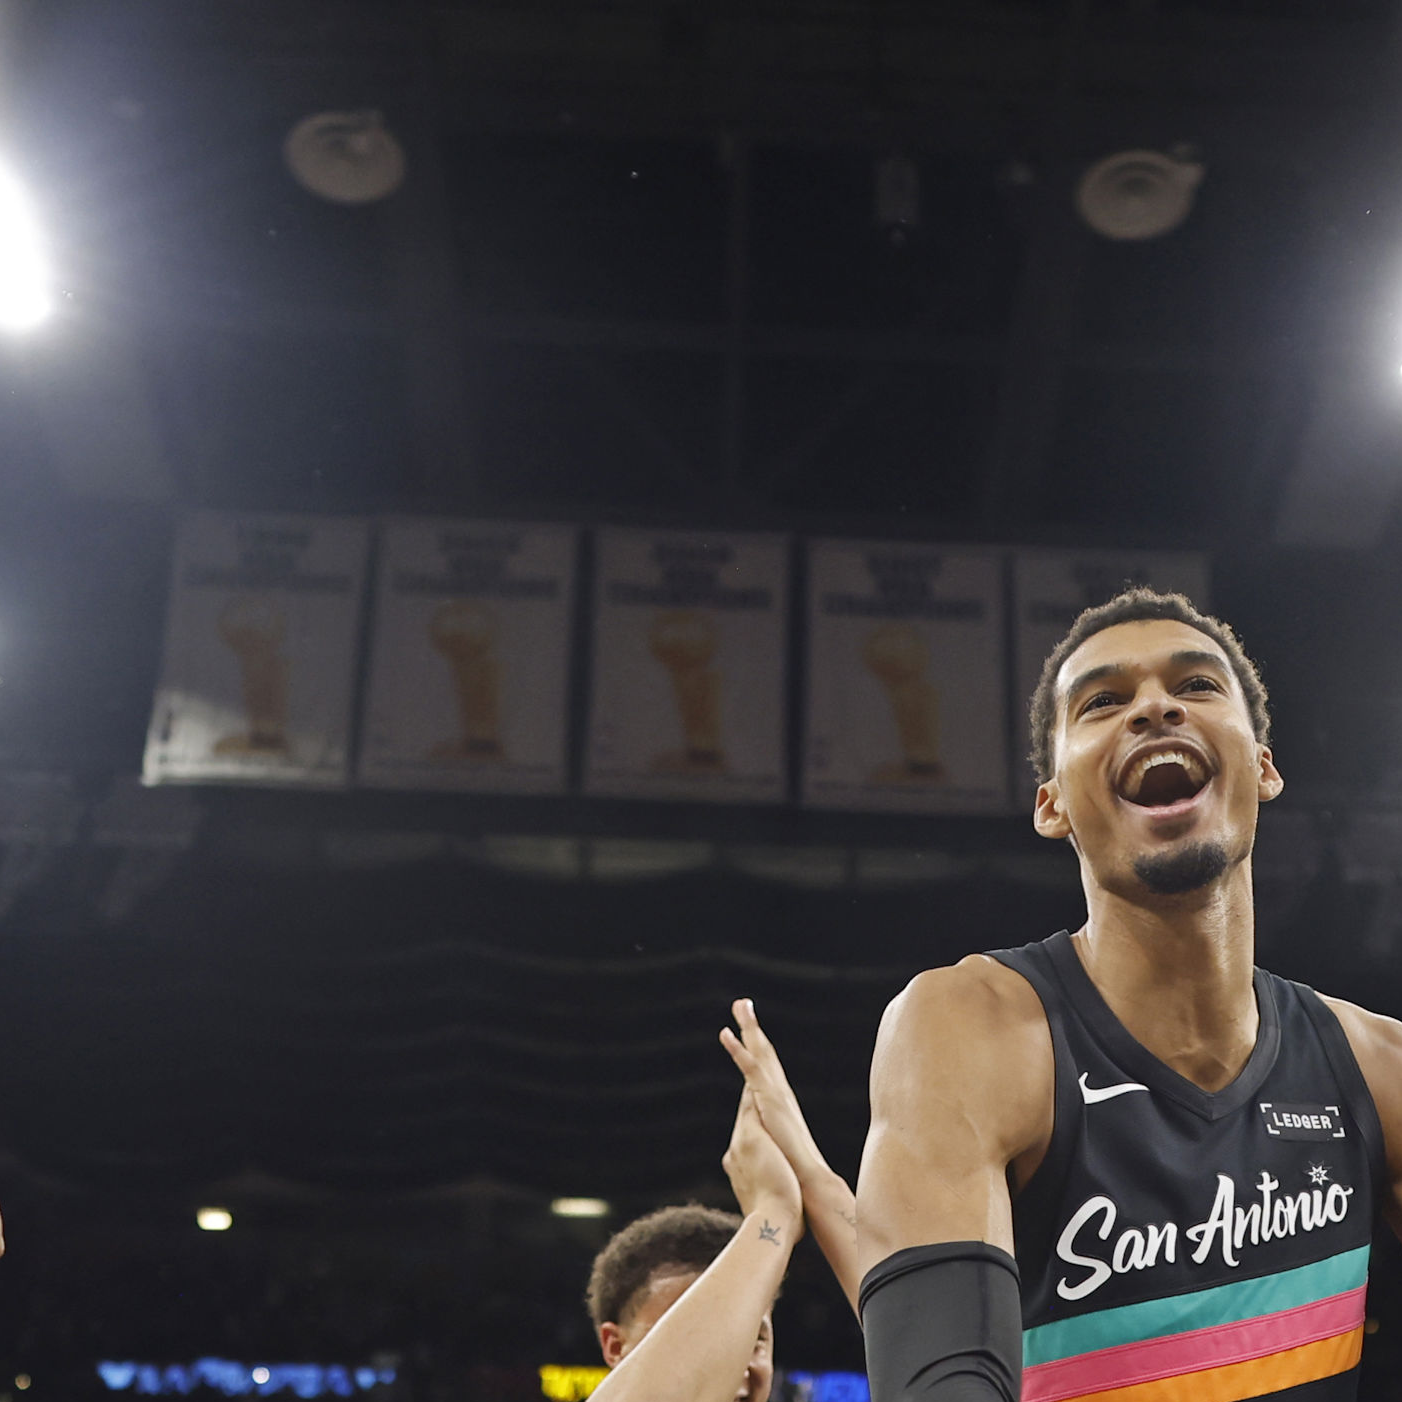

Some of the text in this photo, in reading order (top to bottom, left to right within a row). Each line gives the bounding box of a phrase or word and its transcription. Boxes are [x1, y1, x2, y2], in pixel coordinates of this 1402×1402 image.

[1272, 1111, 1333, 1131] LEDGER
[1055, 1162, 1354, 1301] San Antonio
